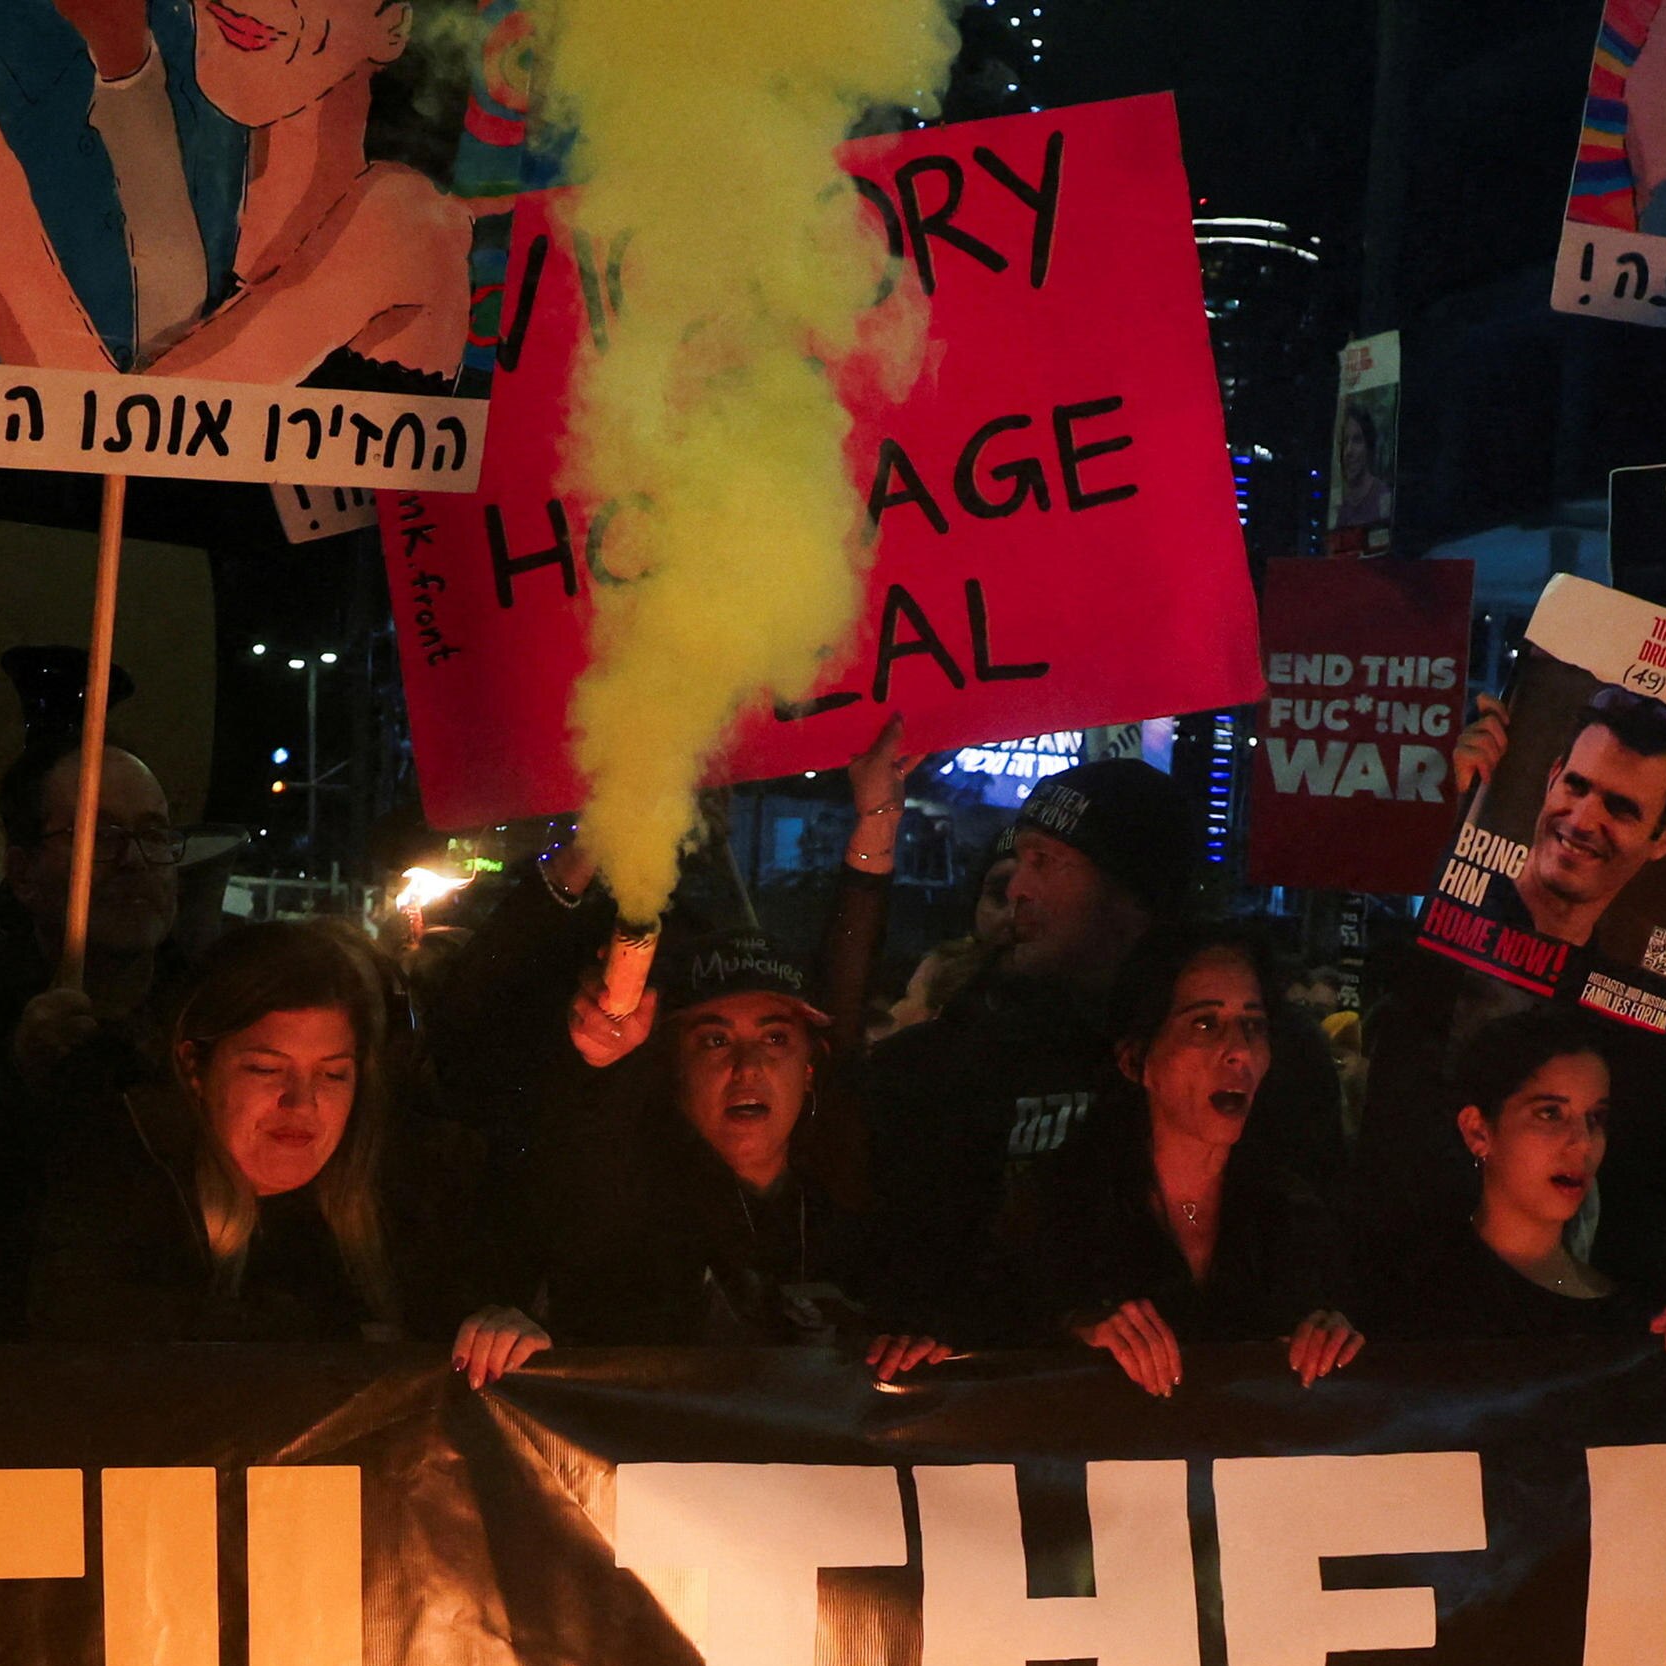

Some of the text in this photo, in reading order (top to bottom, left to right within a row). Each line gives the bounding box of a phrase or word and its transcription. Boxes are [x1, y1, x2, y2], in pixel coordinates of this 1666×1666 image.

[80, 389, 233, 457] אותו
[264, 402, 468, 471] החזירו
[485, 395, 1139, 610] HOAGE
[1268, 652, 1458, 690] END THIS
[1622, 663, 1666, 695] (49)
[1265, 737, 1447, 804] WAR
[1453, 821, 1530, 881] BRING
[1437, 857, 1492, 908] HIM
[1423, 896, 1498, 953] HOME
[1491, 925, 1571, 984] NOW!
[1580, 983, 1633, 1017] FAMILIES
[1587, 970, 1627, 997] HOSTAGES
